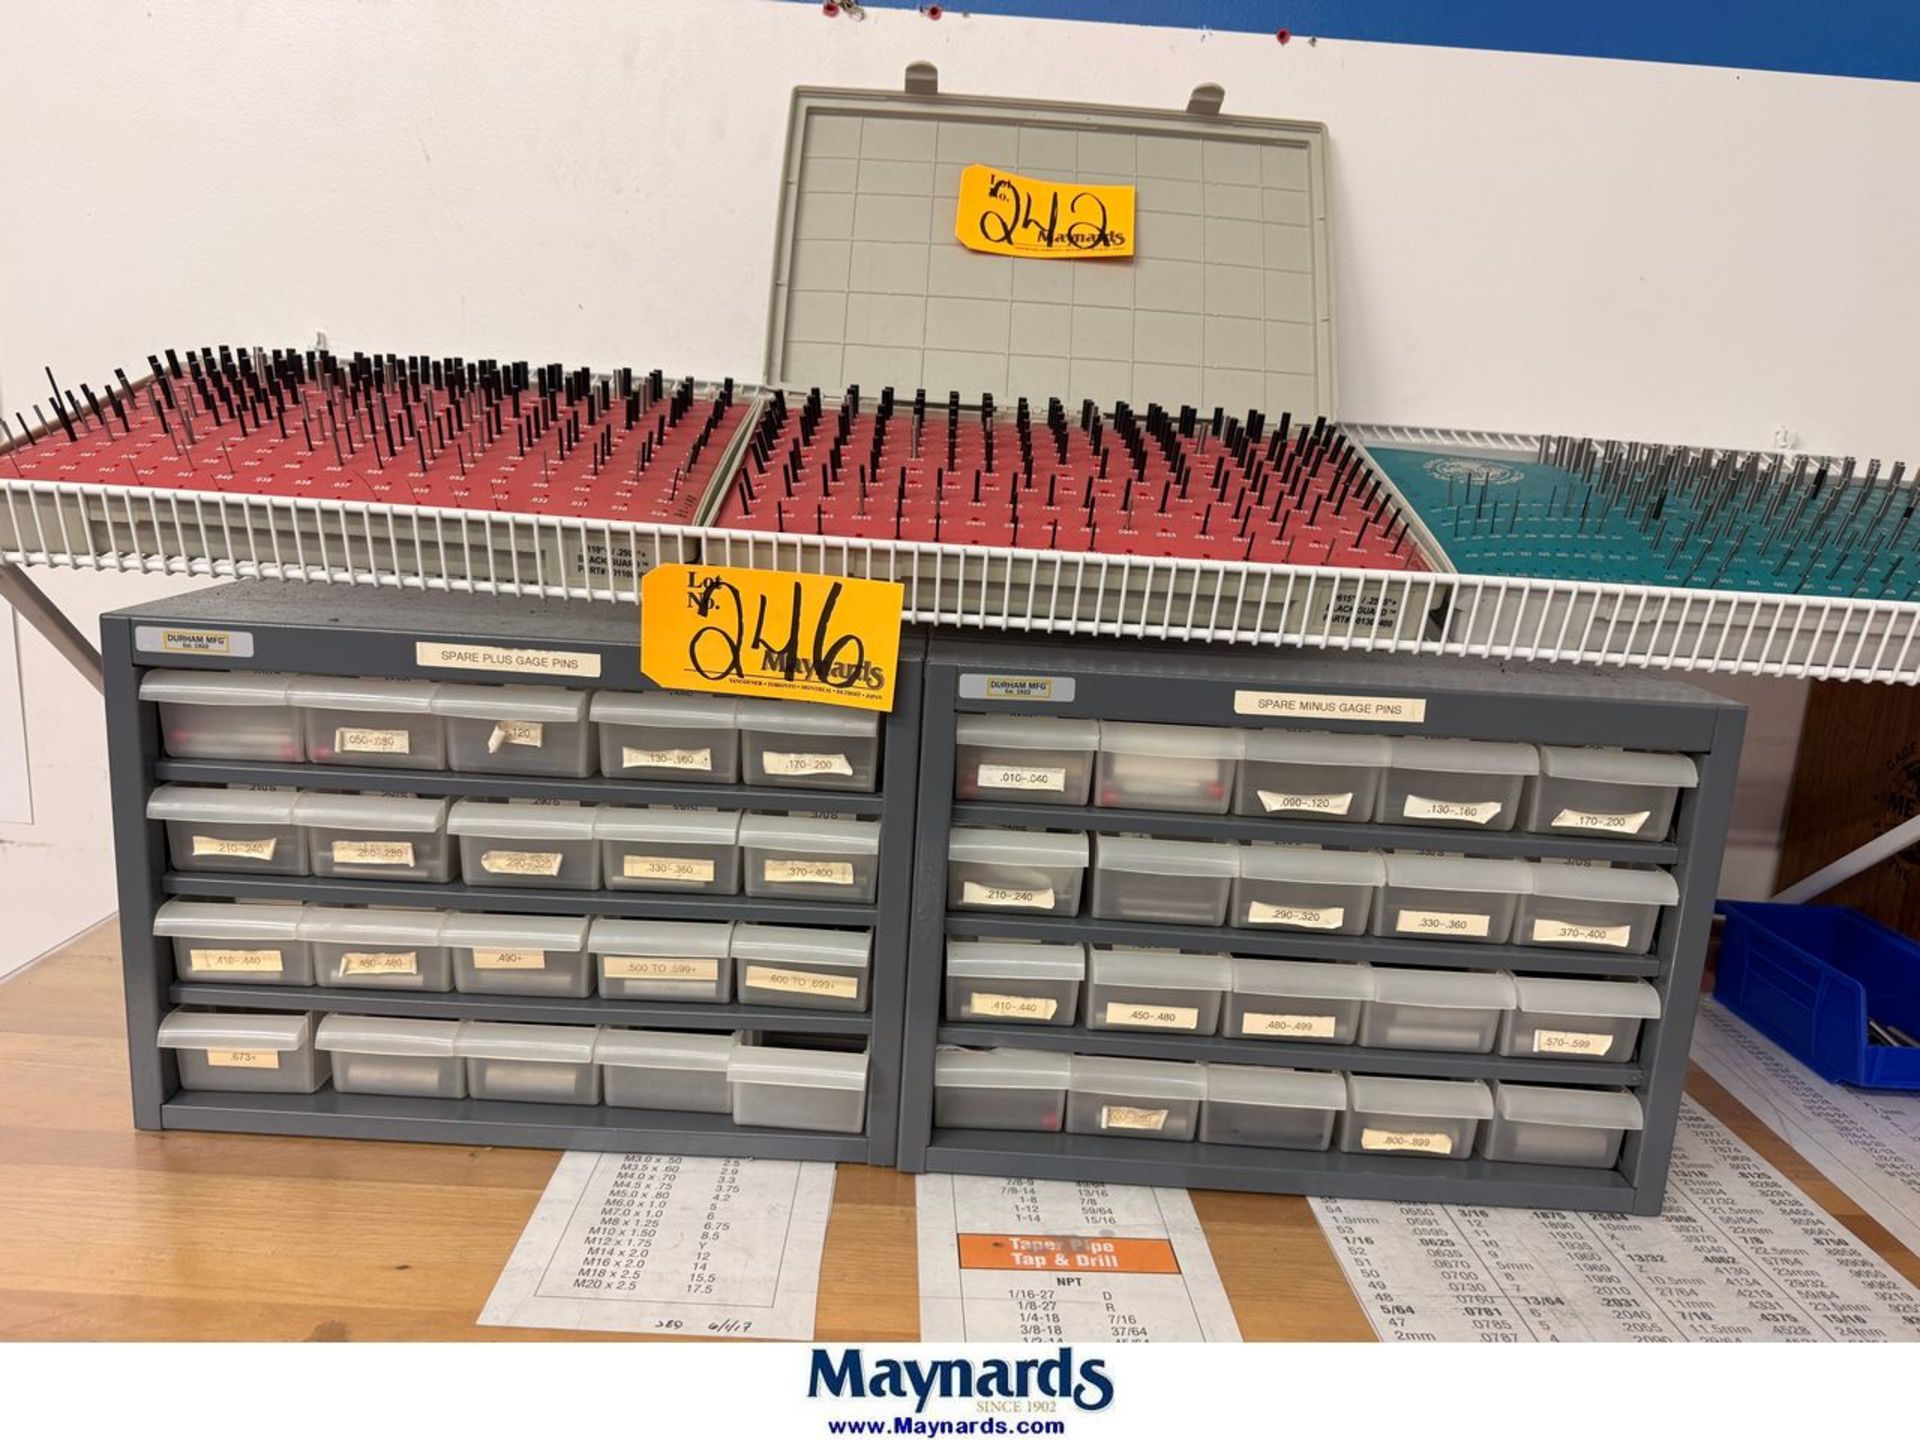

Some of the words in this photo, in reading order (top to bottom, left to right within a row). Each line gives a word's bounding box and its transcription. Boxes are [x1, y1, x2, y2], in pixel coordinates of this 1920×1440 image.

[980, 180, 1110, 249] 242
[688, 571, 721, 589] Lot
[167, 633, 204, 644] DURHAM
[206, 636, 225, 645] MFG
[689, 580, 865, 688] 246
[441, 650, 479, 663] SPARE
[483, 652, 513, 666] PLUS
[516, 654, 549, 668] GAGE
[552, 657, 579, 669] PINS
[991, 680, 1027, 689] DURHAM
[1028, 682, 1047, 691] MFG
[1258, 698, 1296, 711] SPARE
[1299, 700, 1336, 712] MINUS
[1339, 702, 1372, 714] GAGE
[1375, 704, 1402, 715] PINS
[1418, 917, 1467, 930] .330-.360
[1557, 928, 1606, 940] .370-.400
[651, 963, 668, 973] TO
[792, 976, 807, 986] TO
[601, 1207, 631, 1217] M7.0
[645, 1209, 663, 1218] 1.0
[707, 1212, 715, 1220] 6
[1014, 1205, 1038, 1213] 1-12
[1081, 1207, 1113, 1215] 59/64
[1458, 1209, 1488, 1218] 3/16
[600, 1216, 619, 1226] M8
[635, 1219, 659, 1228] 1.25
[704, 1222, 730, 1231] 6.75
[1016, 1214, 1040, 1222] 1-14
[1085, 1216, 1116, 1225] 15/16
[589, 1226, 615, 1236] M10
[630, 1228, 656, 1237] 1.50
[701, 1231, 719, 1241] 8.5
[584, 1236, 610, 1246] M12
[627, 1238, 652, 1248] 1.75
[698, 1241, 706, 1250] Y
[1342, 1236, 1374, 1245] 1/16
[587, 1247, 613, 1256] M14
[626, 1248, 648, 1258] 2.0
[696, 1252, 710, 1261] 12
[1011, 1253, 1045, 1267] Tap
[1055, 1255, 1068, 1267] &
[1077, 1254, 1118, 1267] Drill
[1627, 1253, 1666, 1263] 13/32
[583, 1258, 610, 1267] M16
[624, 1259, 645, 1269] 2.0
[693, 1262, 707, 1271] 14
[578, 1268, 605, 1278] M18
[620, 1270, 641, 1279] 2.5
[690, 1273, 716, 1283] 15.5
[573, 1279, 601, 1289] M20
[616, 1281, 637, 1291] 2.5
[687, 1284, 713, 1294] 17.5
[1057, 1278, 1082, 1286] NPT
[1008, 1290, 1054, 1299] 1/16-27
[1103, 1291, 1112, 1301] D
[1522, 1296, 1564, 1306] 13/64
[1018, 1301, 1057, 1311] 1/8-27
[1106, 1303, 1115, 1312] R
[1380, 1305, 1415, 1315] 5/64
[1462, 1307, 1502, 1317] .0781
[1020, 1314, 1060, 1324] 1/4-18
[1108, 1315, 1137, 1325] 7/16
[1677, 1311, 1713, 1321] 7/16
[1020, 1325, 1062, 1335] 3/8-18
[1111, 1326, 1147, 1337] 37/64
[1394, 1330, 1436, 1341] 2mm
